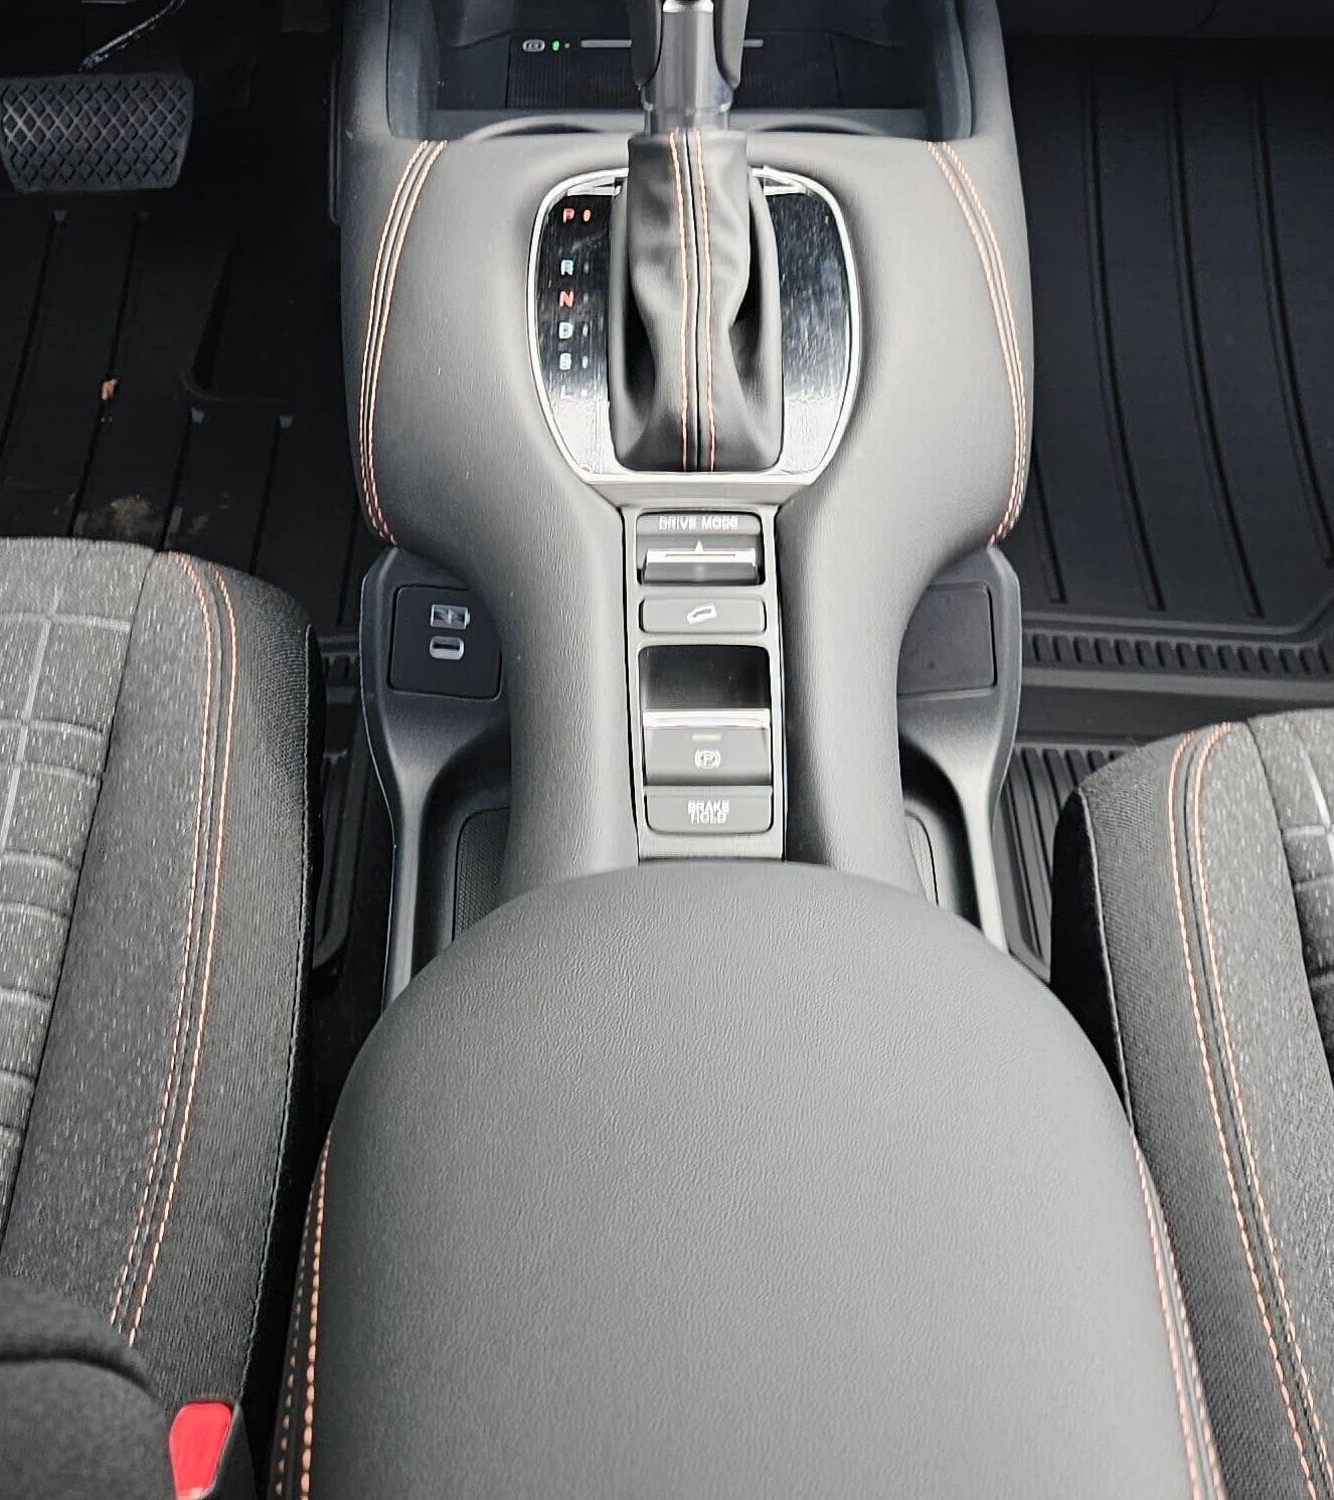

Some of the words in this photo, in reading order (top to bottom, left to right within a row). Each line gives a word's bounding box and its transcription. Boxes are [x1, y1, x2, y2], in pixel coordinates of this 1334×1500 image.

[562, 207, 575, 223] P
[559, 290, 574, 307] N
[558, 322, 573, 339] D
[558, 353, 572, 371] S
[658, 515, 697, 530] DRIVE
[701, 515, 740, 530] MODE
[687, 800, 730, 814] BRAKE
[690, 810, 727, 825] HOLD
